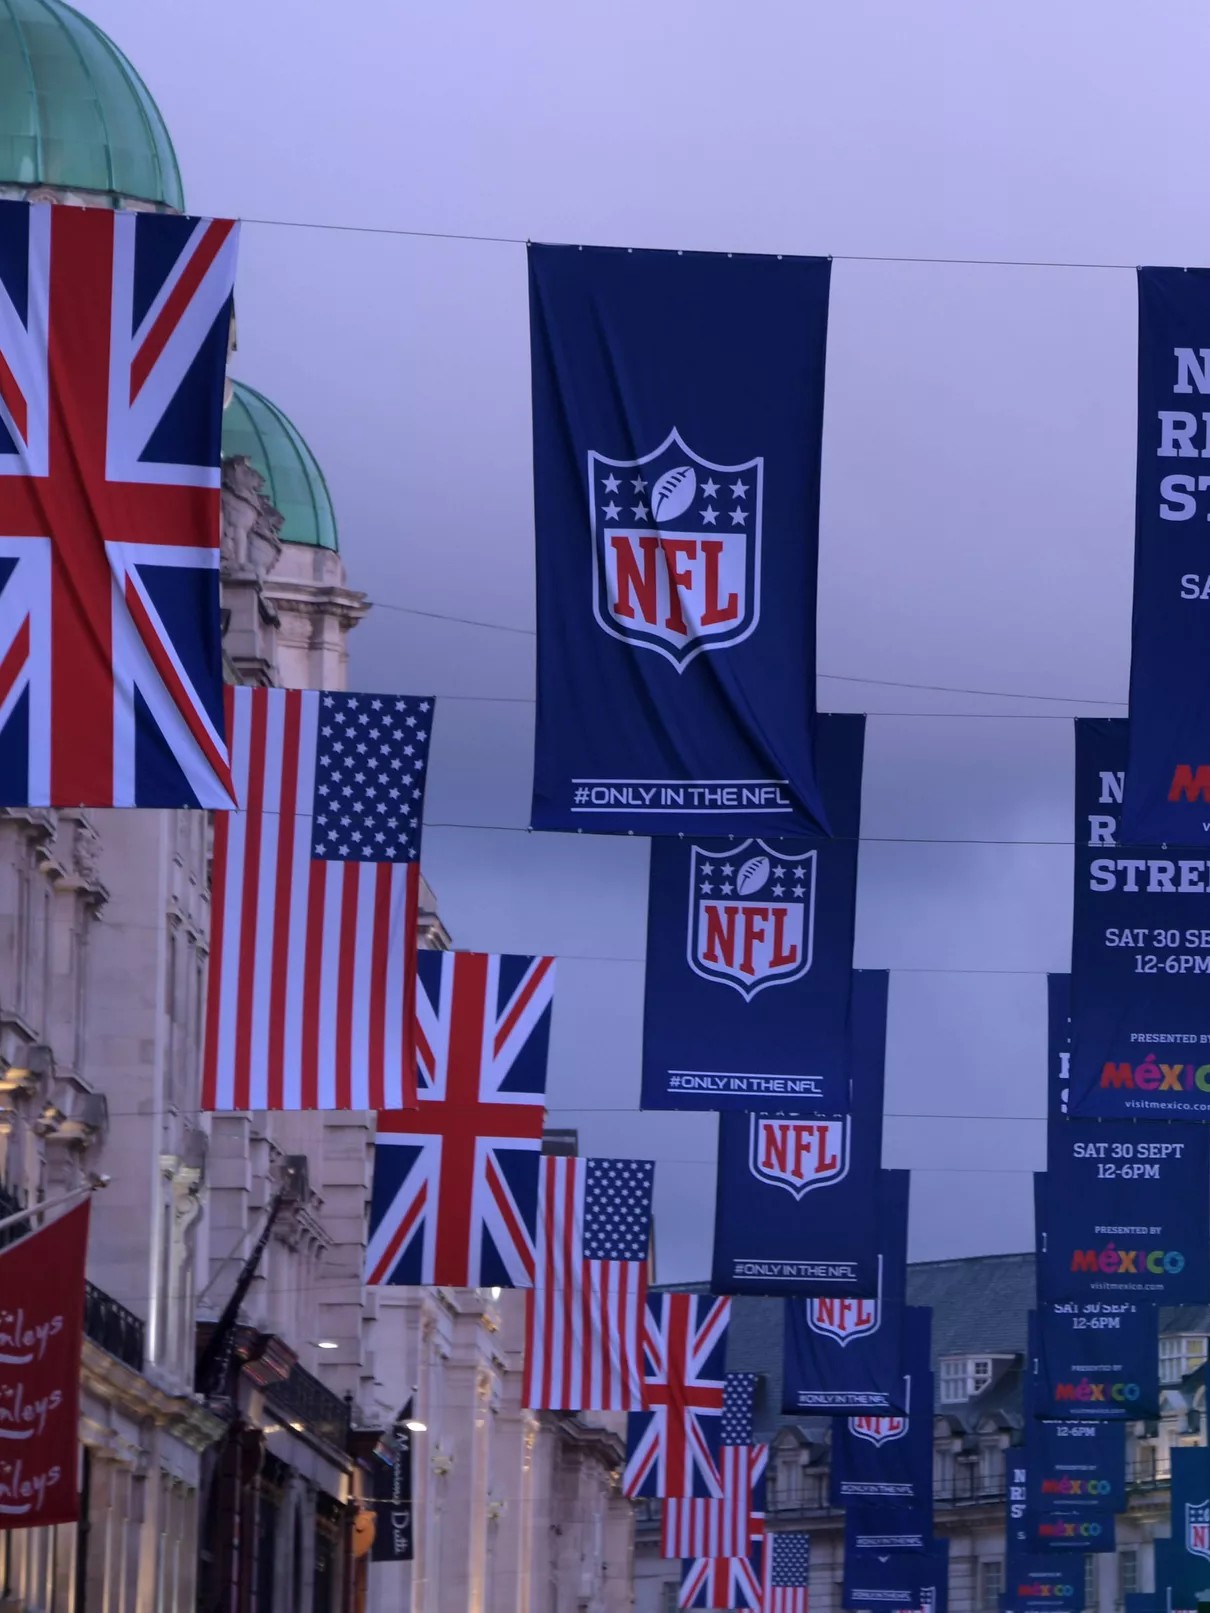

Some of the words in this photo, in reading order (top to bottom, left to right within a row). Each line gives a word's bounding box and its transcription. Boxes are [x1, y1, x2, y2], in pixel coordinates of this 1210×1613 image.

[611, 536, 739, 637] NFL
[703, 905, 797, 977] NFL
[1105, 928, 1148, 947] SAT
[1152, 929, 1180, 948] 30
[1130, 1033, 1197, 1043] PRESENTED
[762, 1124, 837, 1180] NFL
[1073, 1142, 1109, 1158] SAT
[1111, 1143, 1133, 1158] 30
[1137, 1143, 1184, 1159] SEPT
[1097, 1163, 1160, 1179] 12-6PM
[1094, 1226, 1148, 1234] PRESENTED
[1072, 1317, 1120, 1329] 12-6PM
